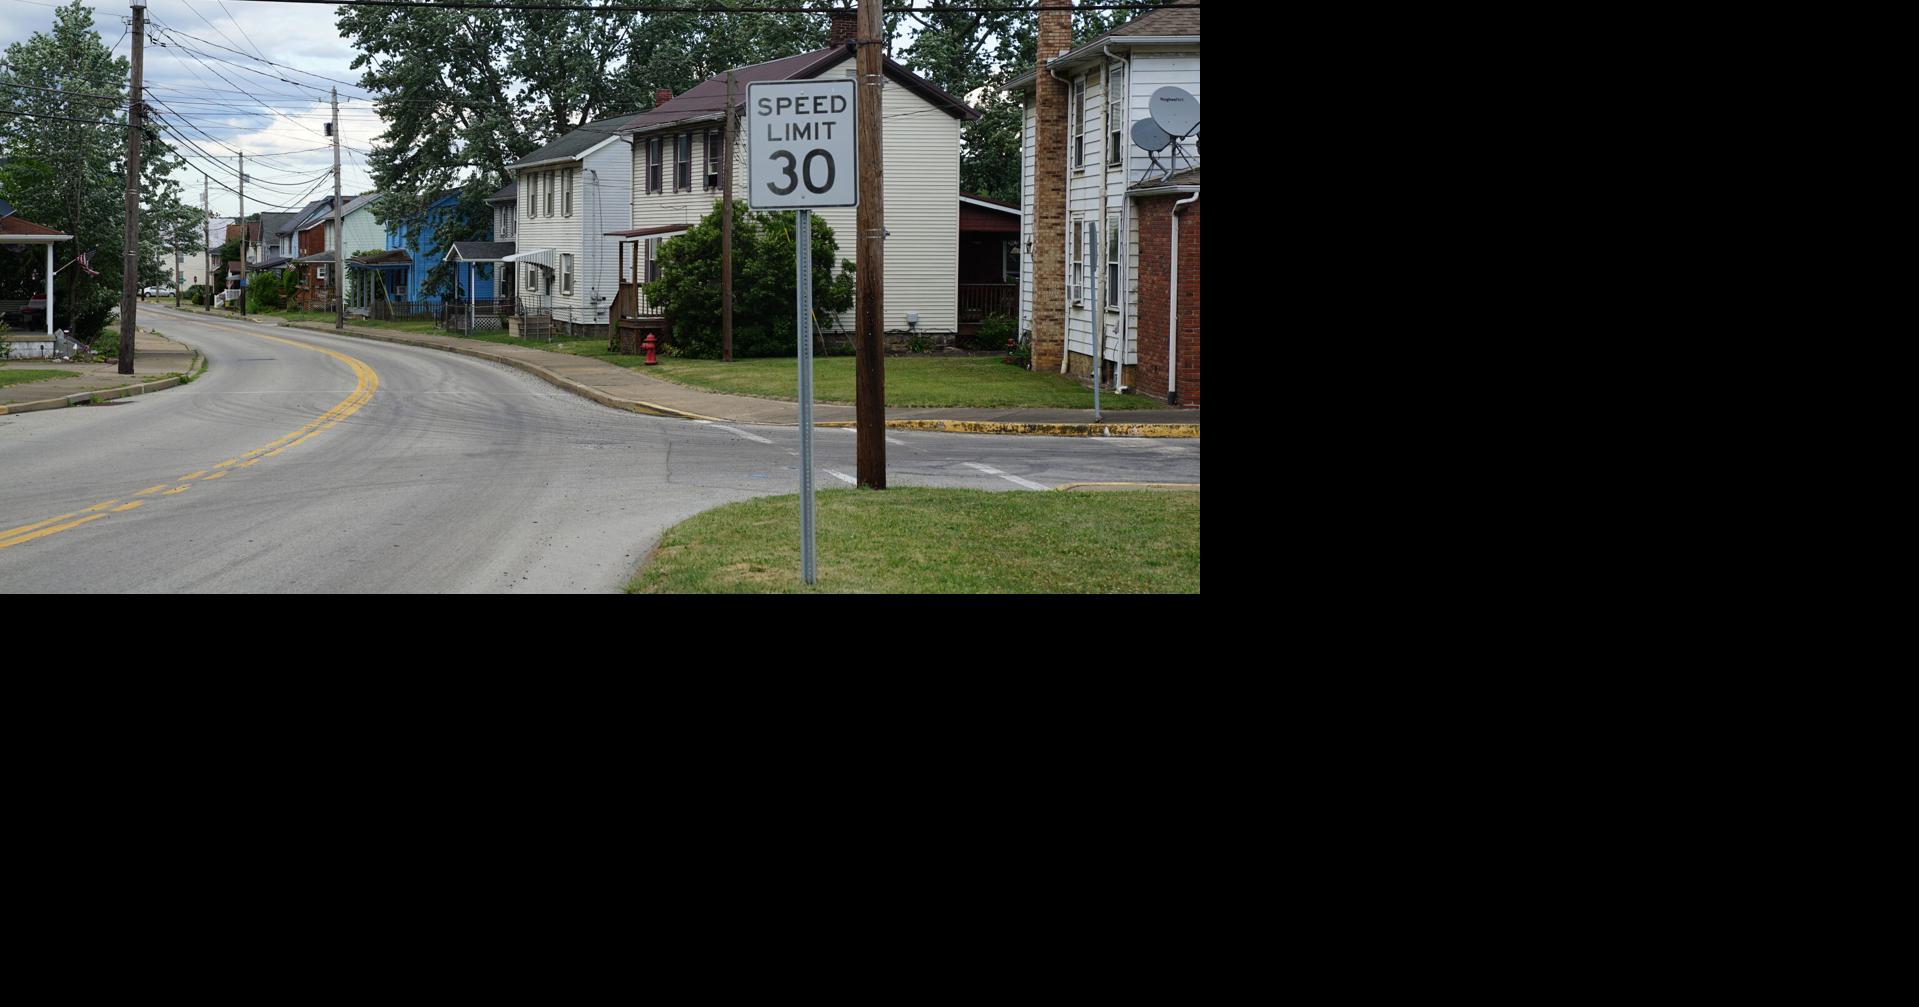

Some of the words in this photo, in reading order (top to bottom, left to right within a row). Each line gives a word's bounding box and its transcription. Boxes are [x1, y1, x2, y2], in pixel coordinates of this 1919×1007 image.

[758, 95, 847, 116] SPEED
[767, 121, 837, 141] LIMIT
[766, 148, 836, 196] 30
